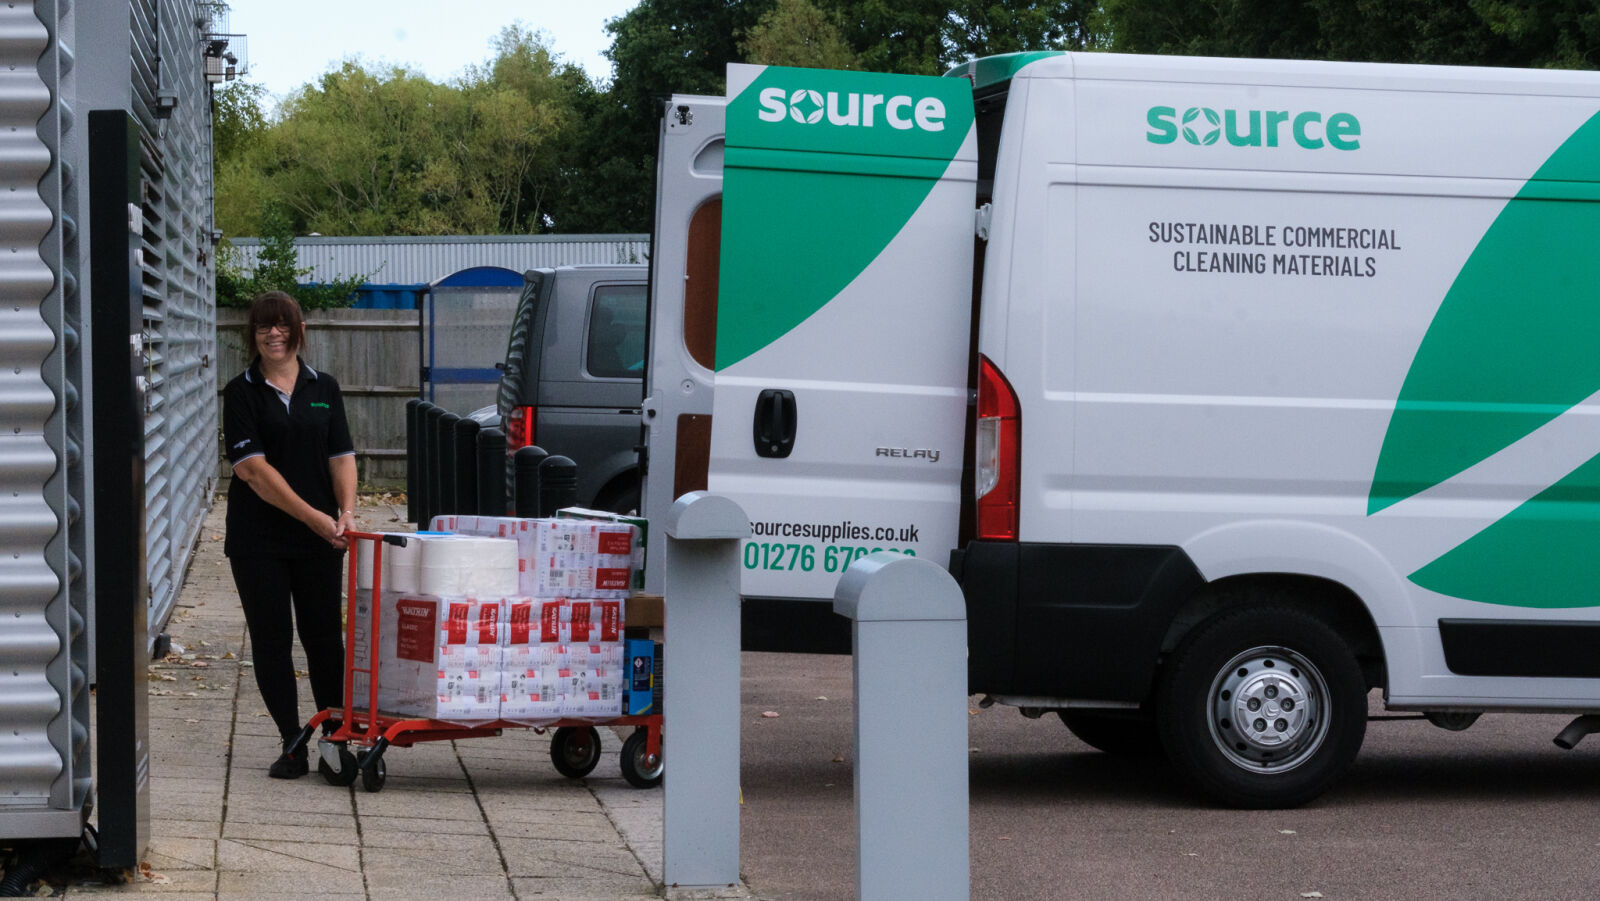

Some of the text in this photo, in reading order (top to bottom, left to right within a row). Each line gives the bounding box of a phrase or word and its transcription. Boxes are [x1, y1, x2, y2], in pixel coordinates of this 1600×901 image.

[758, 87, 946, 132] source
[1146, 105, 1361, 151] source
[1149, 221, 1401, 250] SUSTAINABLE COMMERCIAL
[1173, 251, 1376, 278] CLEANING MATERIALS
[875, 447, 940, 463] RELAY
[743, 542, 815, 572] 01276
